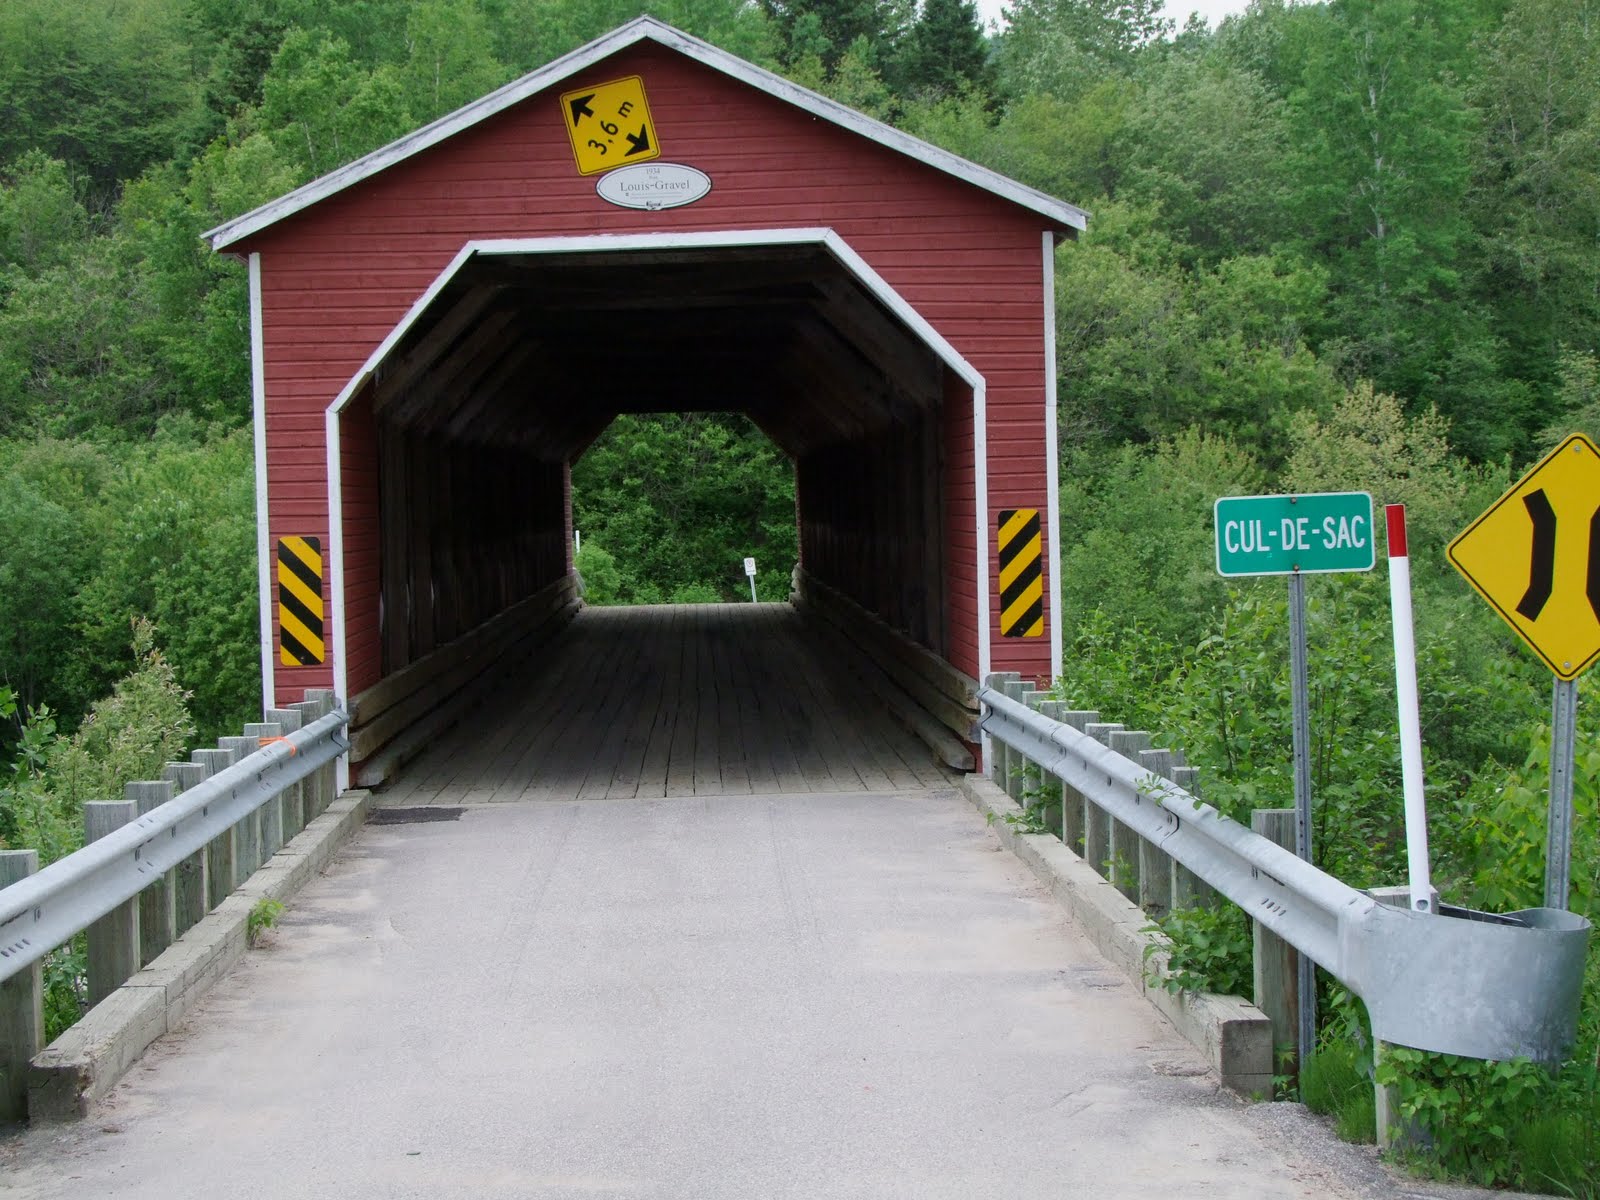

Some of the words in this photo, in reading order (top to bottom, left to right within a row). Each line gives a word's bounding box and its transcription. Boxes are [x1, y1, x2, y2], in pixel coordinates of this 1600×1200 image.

[588, 120, 619, 155] 3,6
[617, 101, 634, 118] m
[646, 167, 661, 175] 1934
[620, 179, 690, 192] Louis-Gravel
[1225, 515, 1366, 553] CUL-DE-SAC
